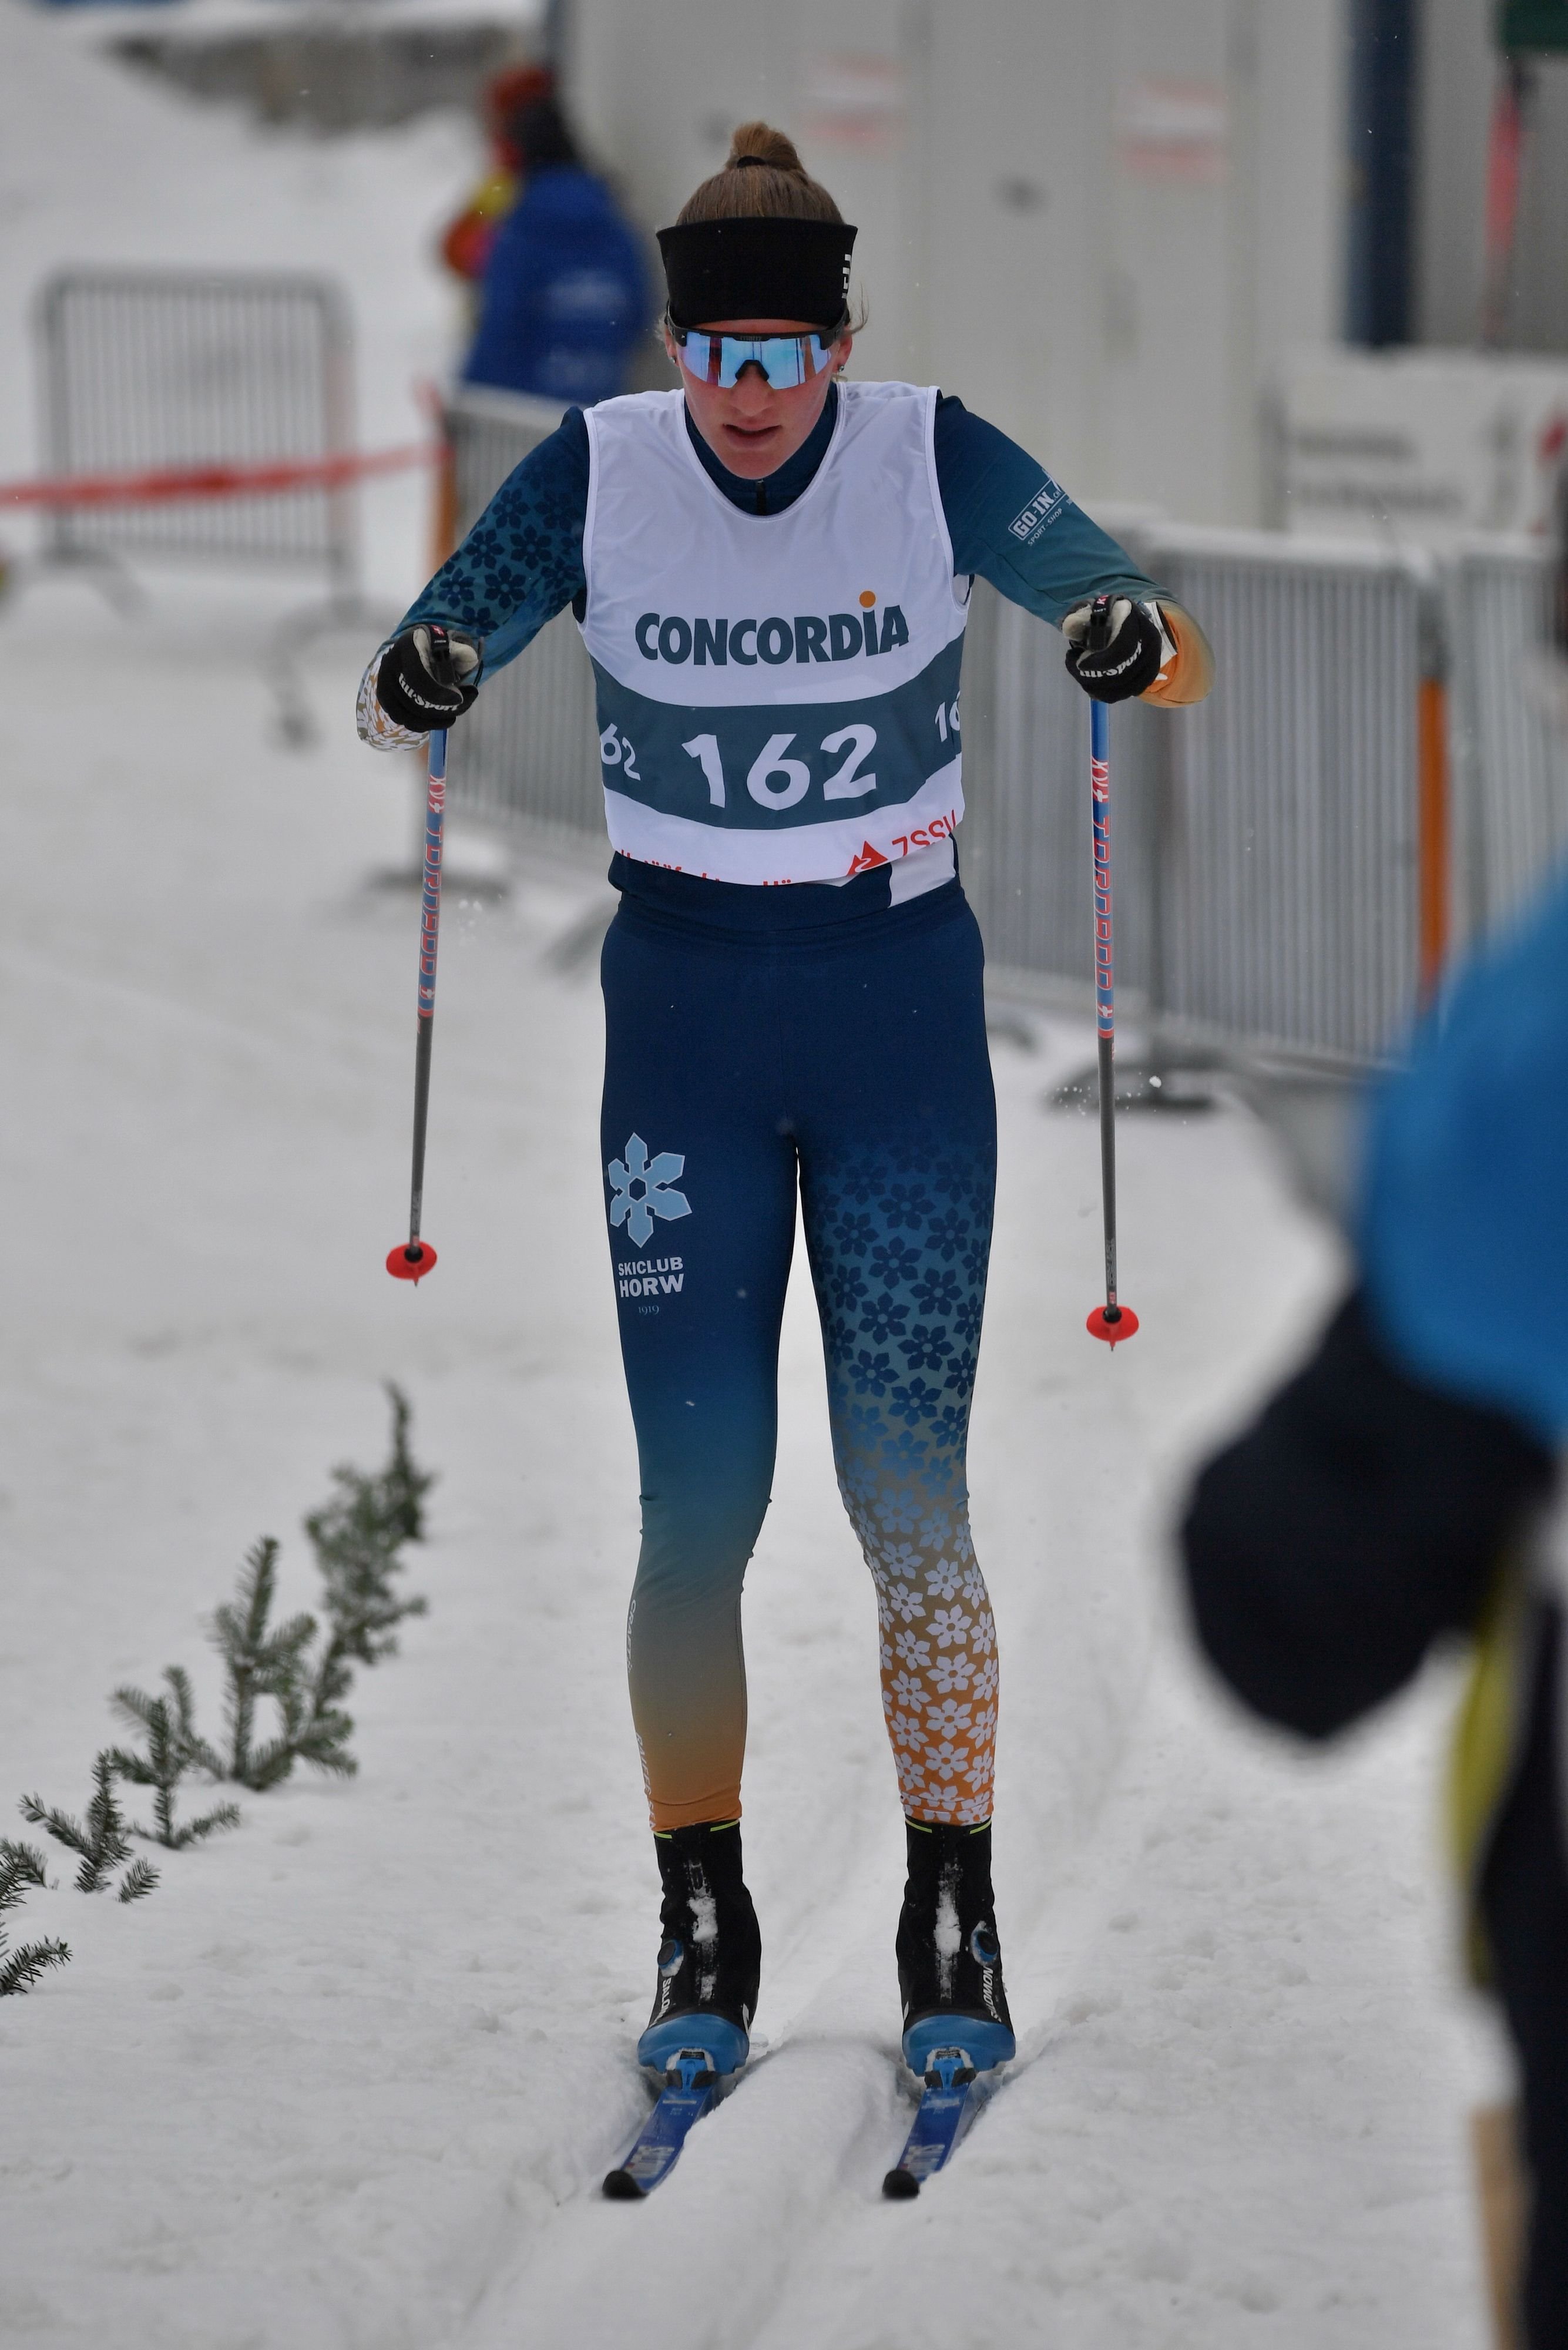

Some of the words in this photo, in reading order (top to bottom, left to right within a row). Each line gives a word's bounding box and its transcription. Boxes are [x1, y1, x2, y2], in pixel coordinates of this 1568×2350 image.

[1028, 525, 1046, 546] SPORT
[1047, 508, 1062, 525] SHOP
[682, 724, 877, 811] 162
[618, 1257, 683, 1277] SKICLUB
[619, 1273, 684, 1298] HORW
[639, 1305, 660, 1315] 1919
